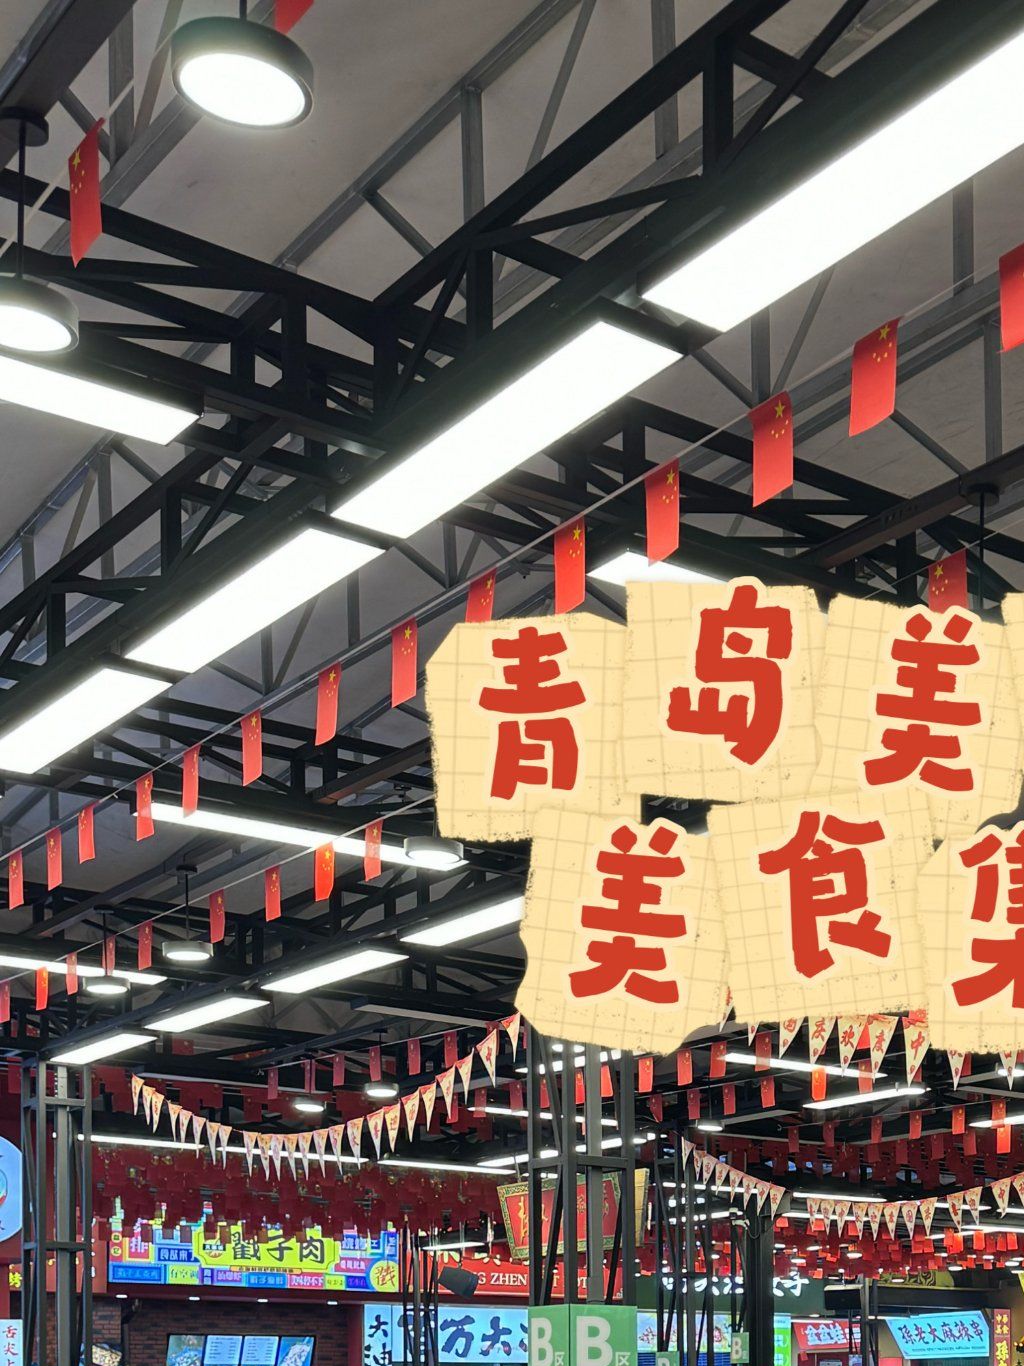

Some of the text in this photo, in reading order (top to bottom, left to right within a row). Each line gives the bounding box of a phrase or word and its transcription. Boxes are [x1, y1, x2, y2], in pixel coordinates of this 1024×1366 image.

[911, 1031, 925, 1059] 中
[490, 1272, 527, 1286] ZHEN
[898, 1320, 984, 1345] 孫老大麻辣串
